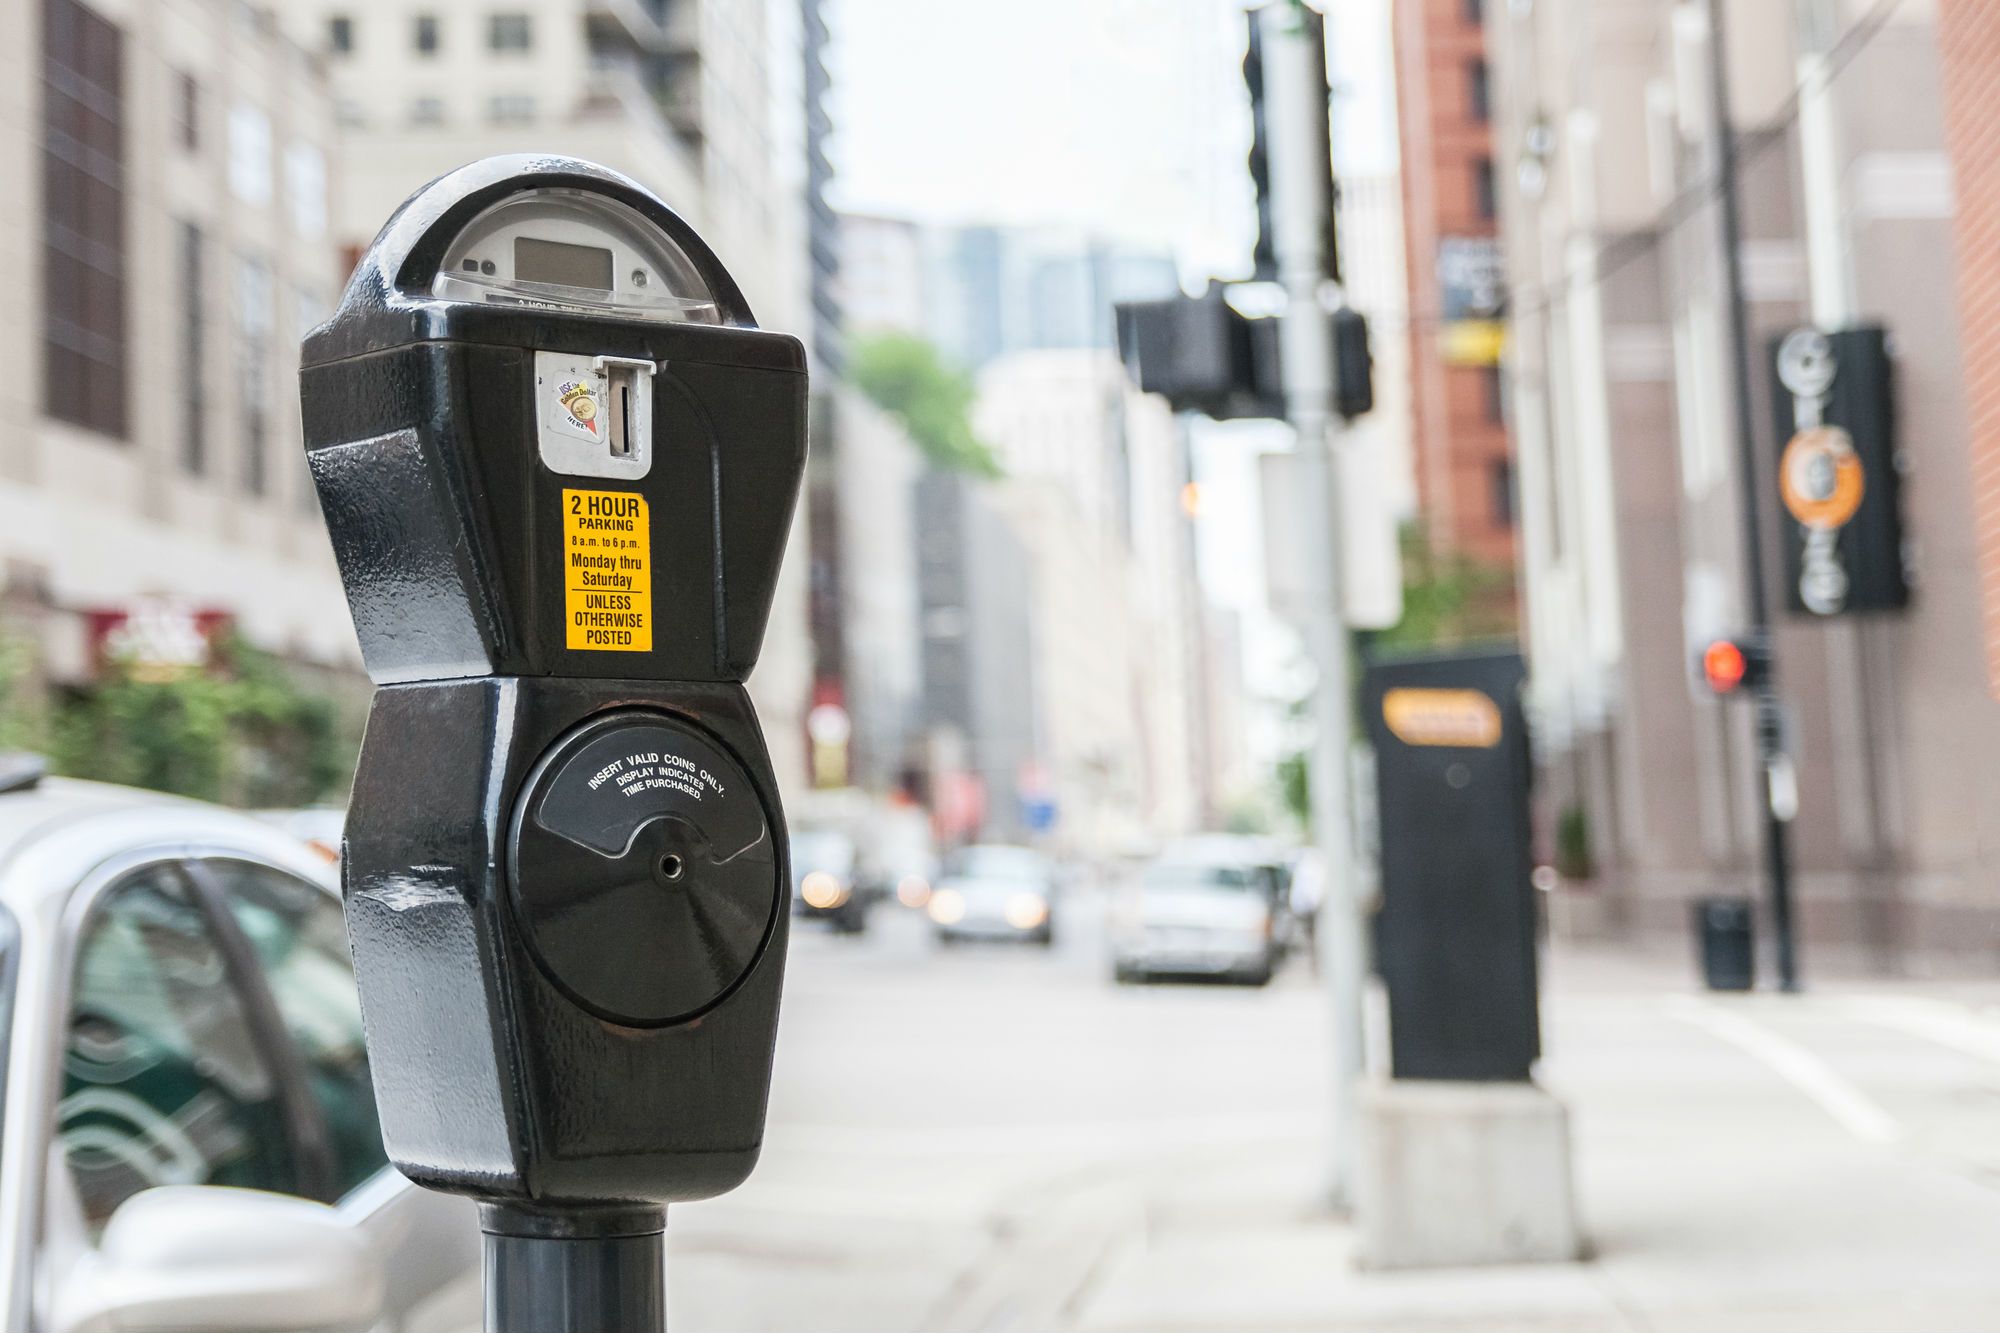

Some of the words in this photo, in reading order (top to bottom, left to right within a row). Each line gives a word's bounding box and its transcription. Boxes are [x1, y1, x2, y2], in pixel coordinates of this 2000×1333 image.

[559, 382, 573, 395] USE
[579, 388, 597, 396] Dollar
[571, 495, 581, 515] 2
[588, 496, 640, 518] HOUR
[578, 517, 634, 532] PARKING
[571, 535, 577, 546] 8
[580, 537, 600, 547] a.m.
[602, 537, 610, 547] to
[612, 537, 618, 548] 6
[620, 539, 640, 550] p.m.
[571, 552, 616, 572] Monday
[620, 555, 642, 570] thru
[582, 571, 632, 590] Saturday
[586, 594, 631, 610] UNLESS
[575, 611, 643, 628] OTHERWISE
[586, 630, 632, 645] POSTED
[587, 759, 624, 791] INSERT
[626, 752, 659, 766] VALID
[663, 753, 696, 773] COINS
[700, 769, 725, 798] ONLY.
[616, 766, 654, 787] DISPLAY
[658, 766, 704, 791] INDICATES
[621, 781, 645, 798] TIME
[645, 778, 702, 801] PURCHASED.
